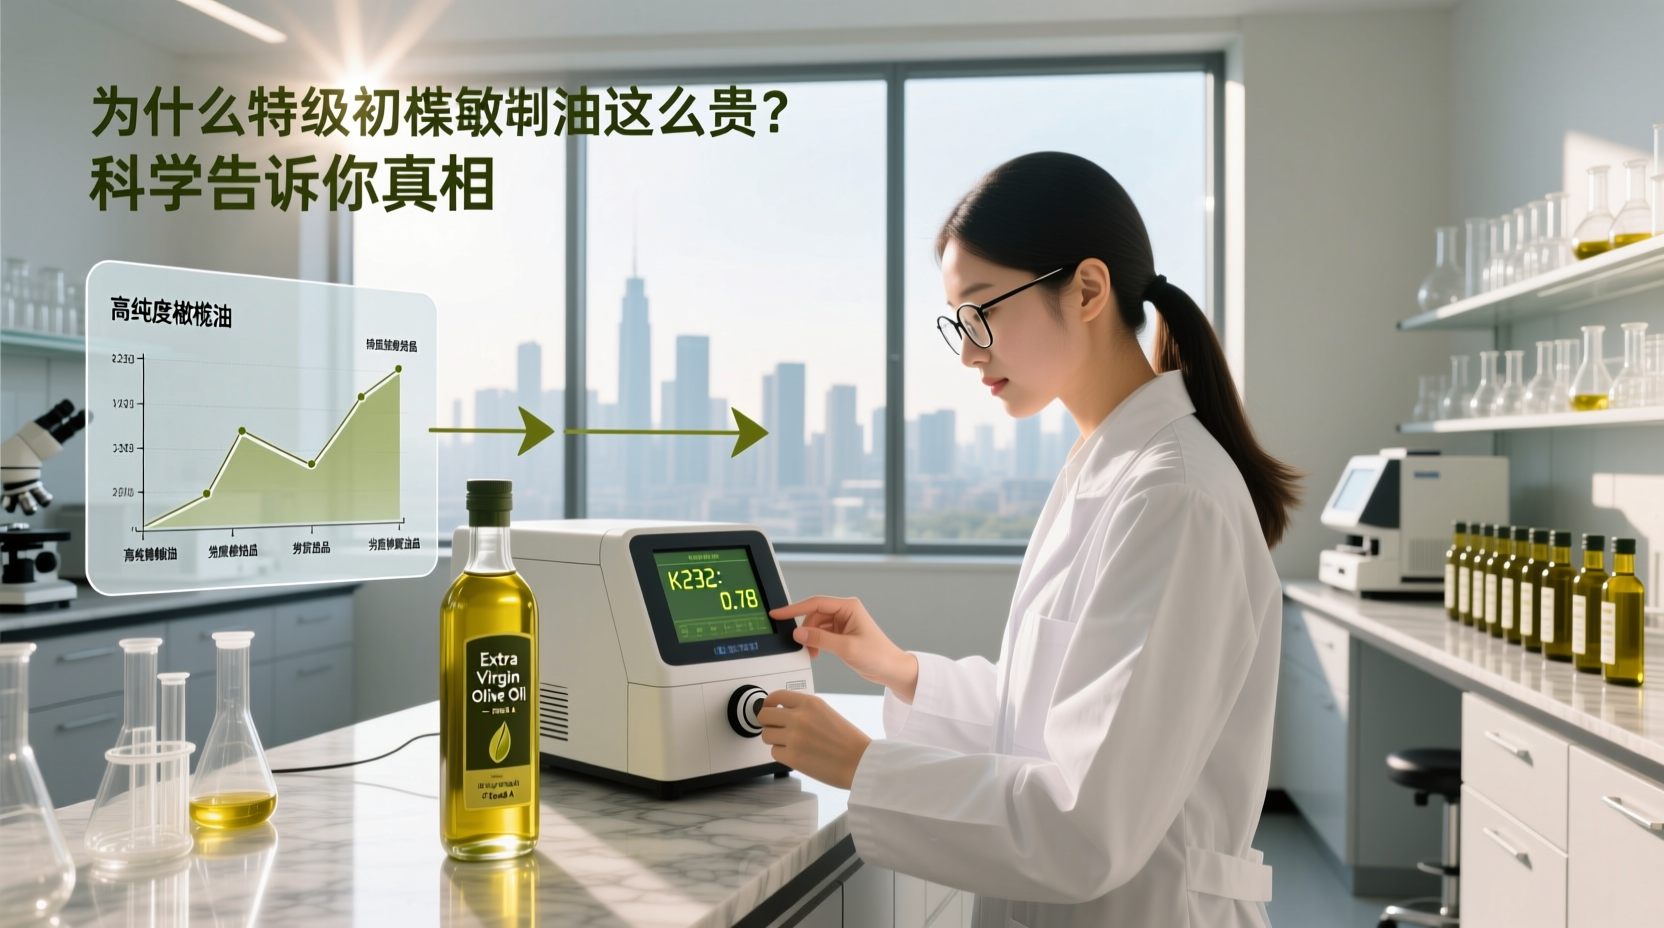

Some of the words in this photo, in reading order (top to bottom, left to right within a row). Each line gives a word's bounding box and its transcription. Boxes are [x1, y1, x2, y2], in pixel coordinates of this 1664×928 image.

[668, 568, 722, 590] K232:
[720, 588, 759, 610] 0.78
[480, 652, 518, 667] Extra
[476, 670, 520, 689] Virgin
[472, 687, 505, 703] Olive
